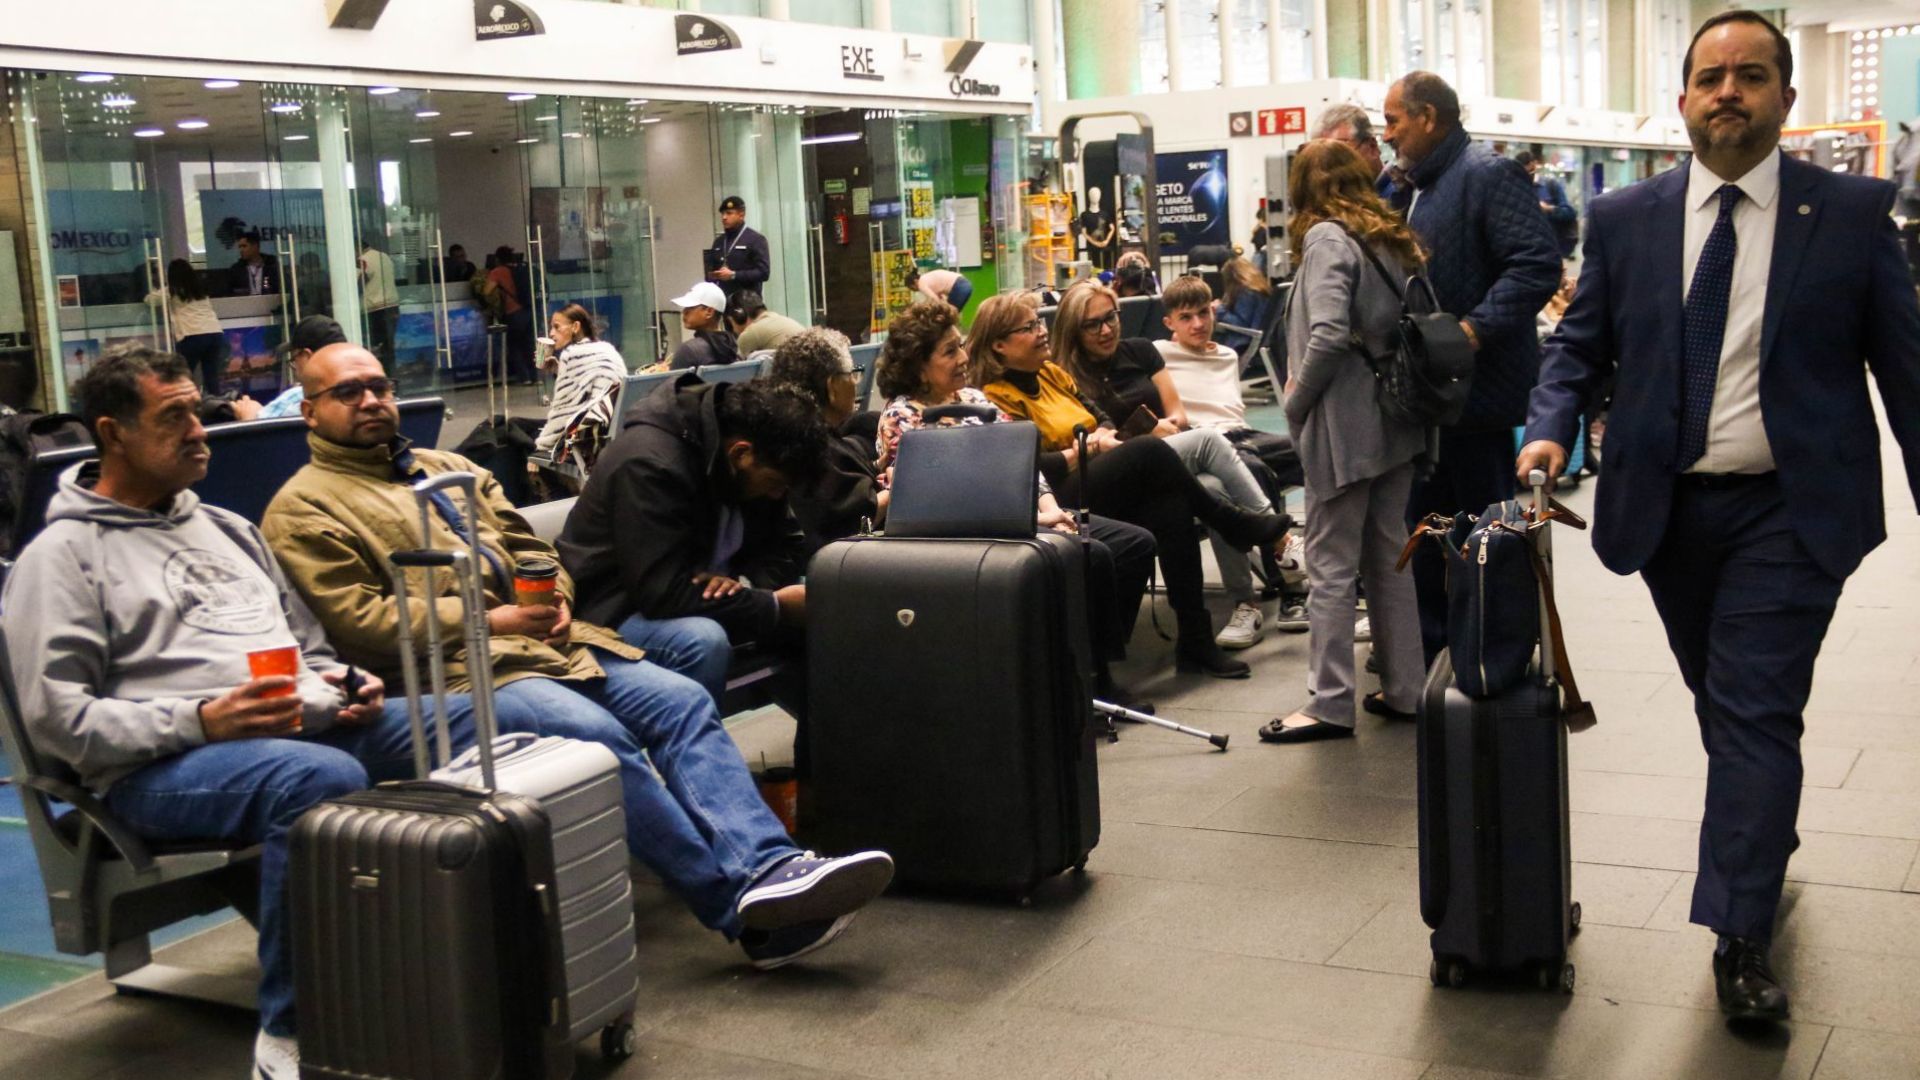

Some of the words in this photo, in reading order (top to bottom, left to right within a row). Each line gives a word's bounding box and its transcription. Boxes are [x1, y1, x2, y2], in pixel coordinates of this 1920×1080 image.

[841, 46, 875, 73] EXE
[1164, 197, 1193, 205] MARCA
[1165, 205, 1194, 215] LENTES
[1157, 213, 1208, 224] UNCIONALES
